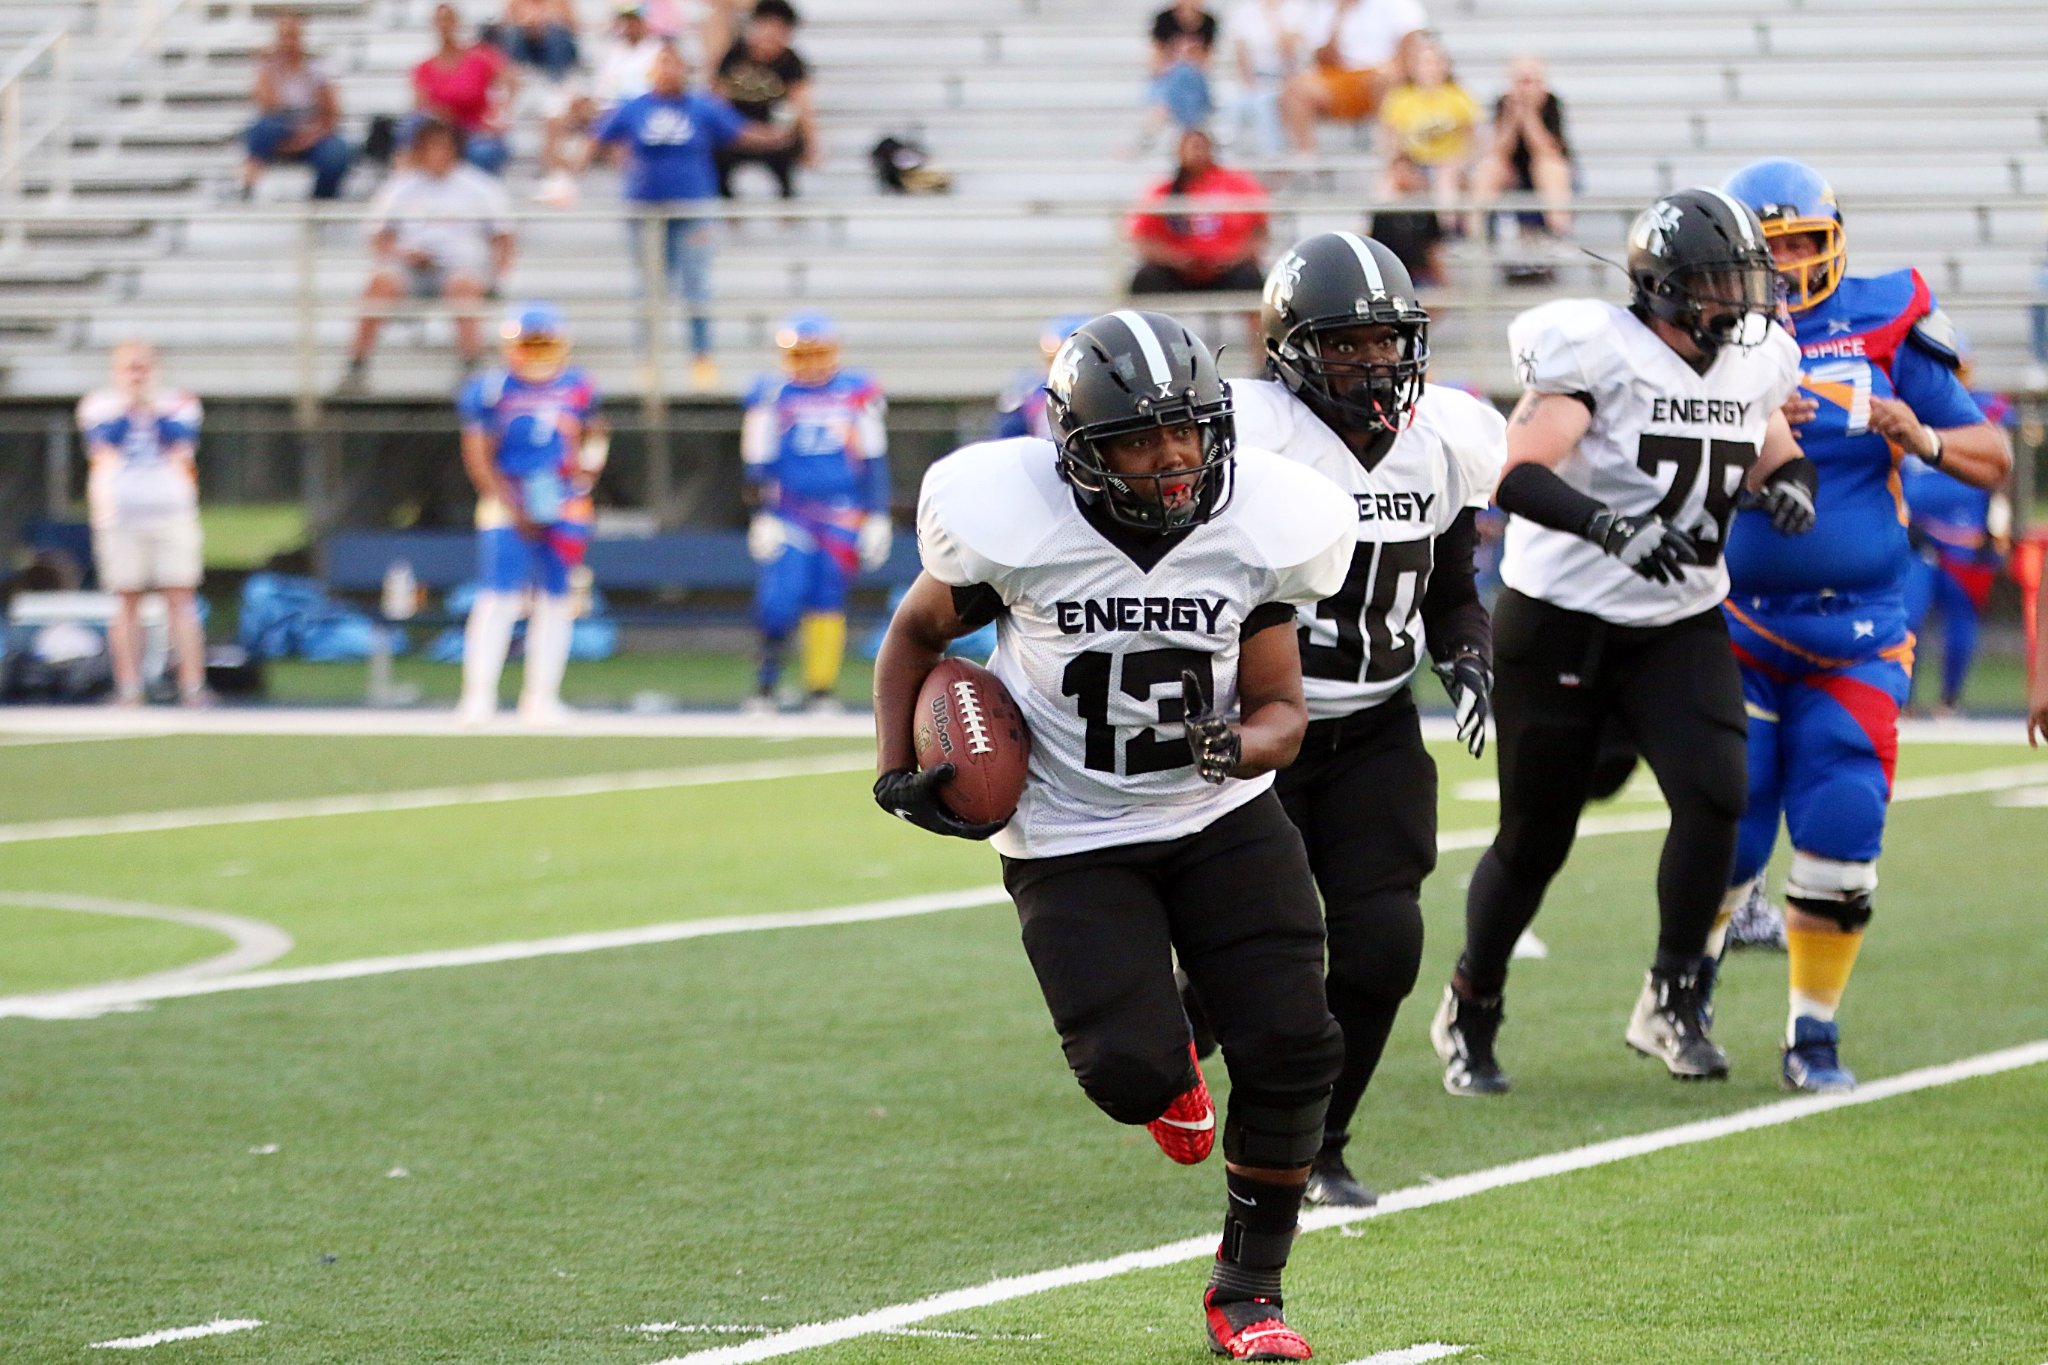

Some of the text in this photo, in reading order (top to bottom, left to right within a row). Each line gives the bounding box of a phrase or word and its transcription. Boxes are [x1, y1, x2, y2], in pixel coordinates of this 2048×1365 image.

[1652, 398, 1751, 426] ENERGY
[1799, 360, 1872, 436] 7
[1351, 493, 1436, 522] ERGY
[1056, 597, 1228, 635] ENERGY
[931, 692, 954, 757] Wilson
[1062, 648, 1215, 776] 13
